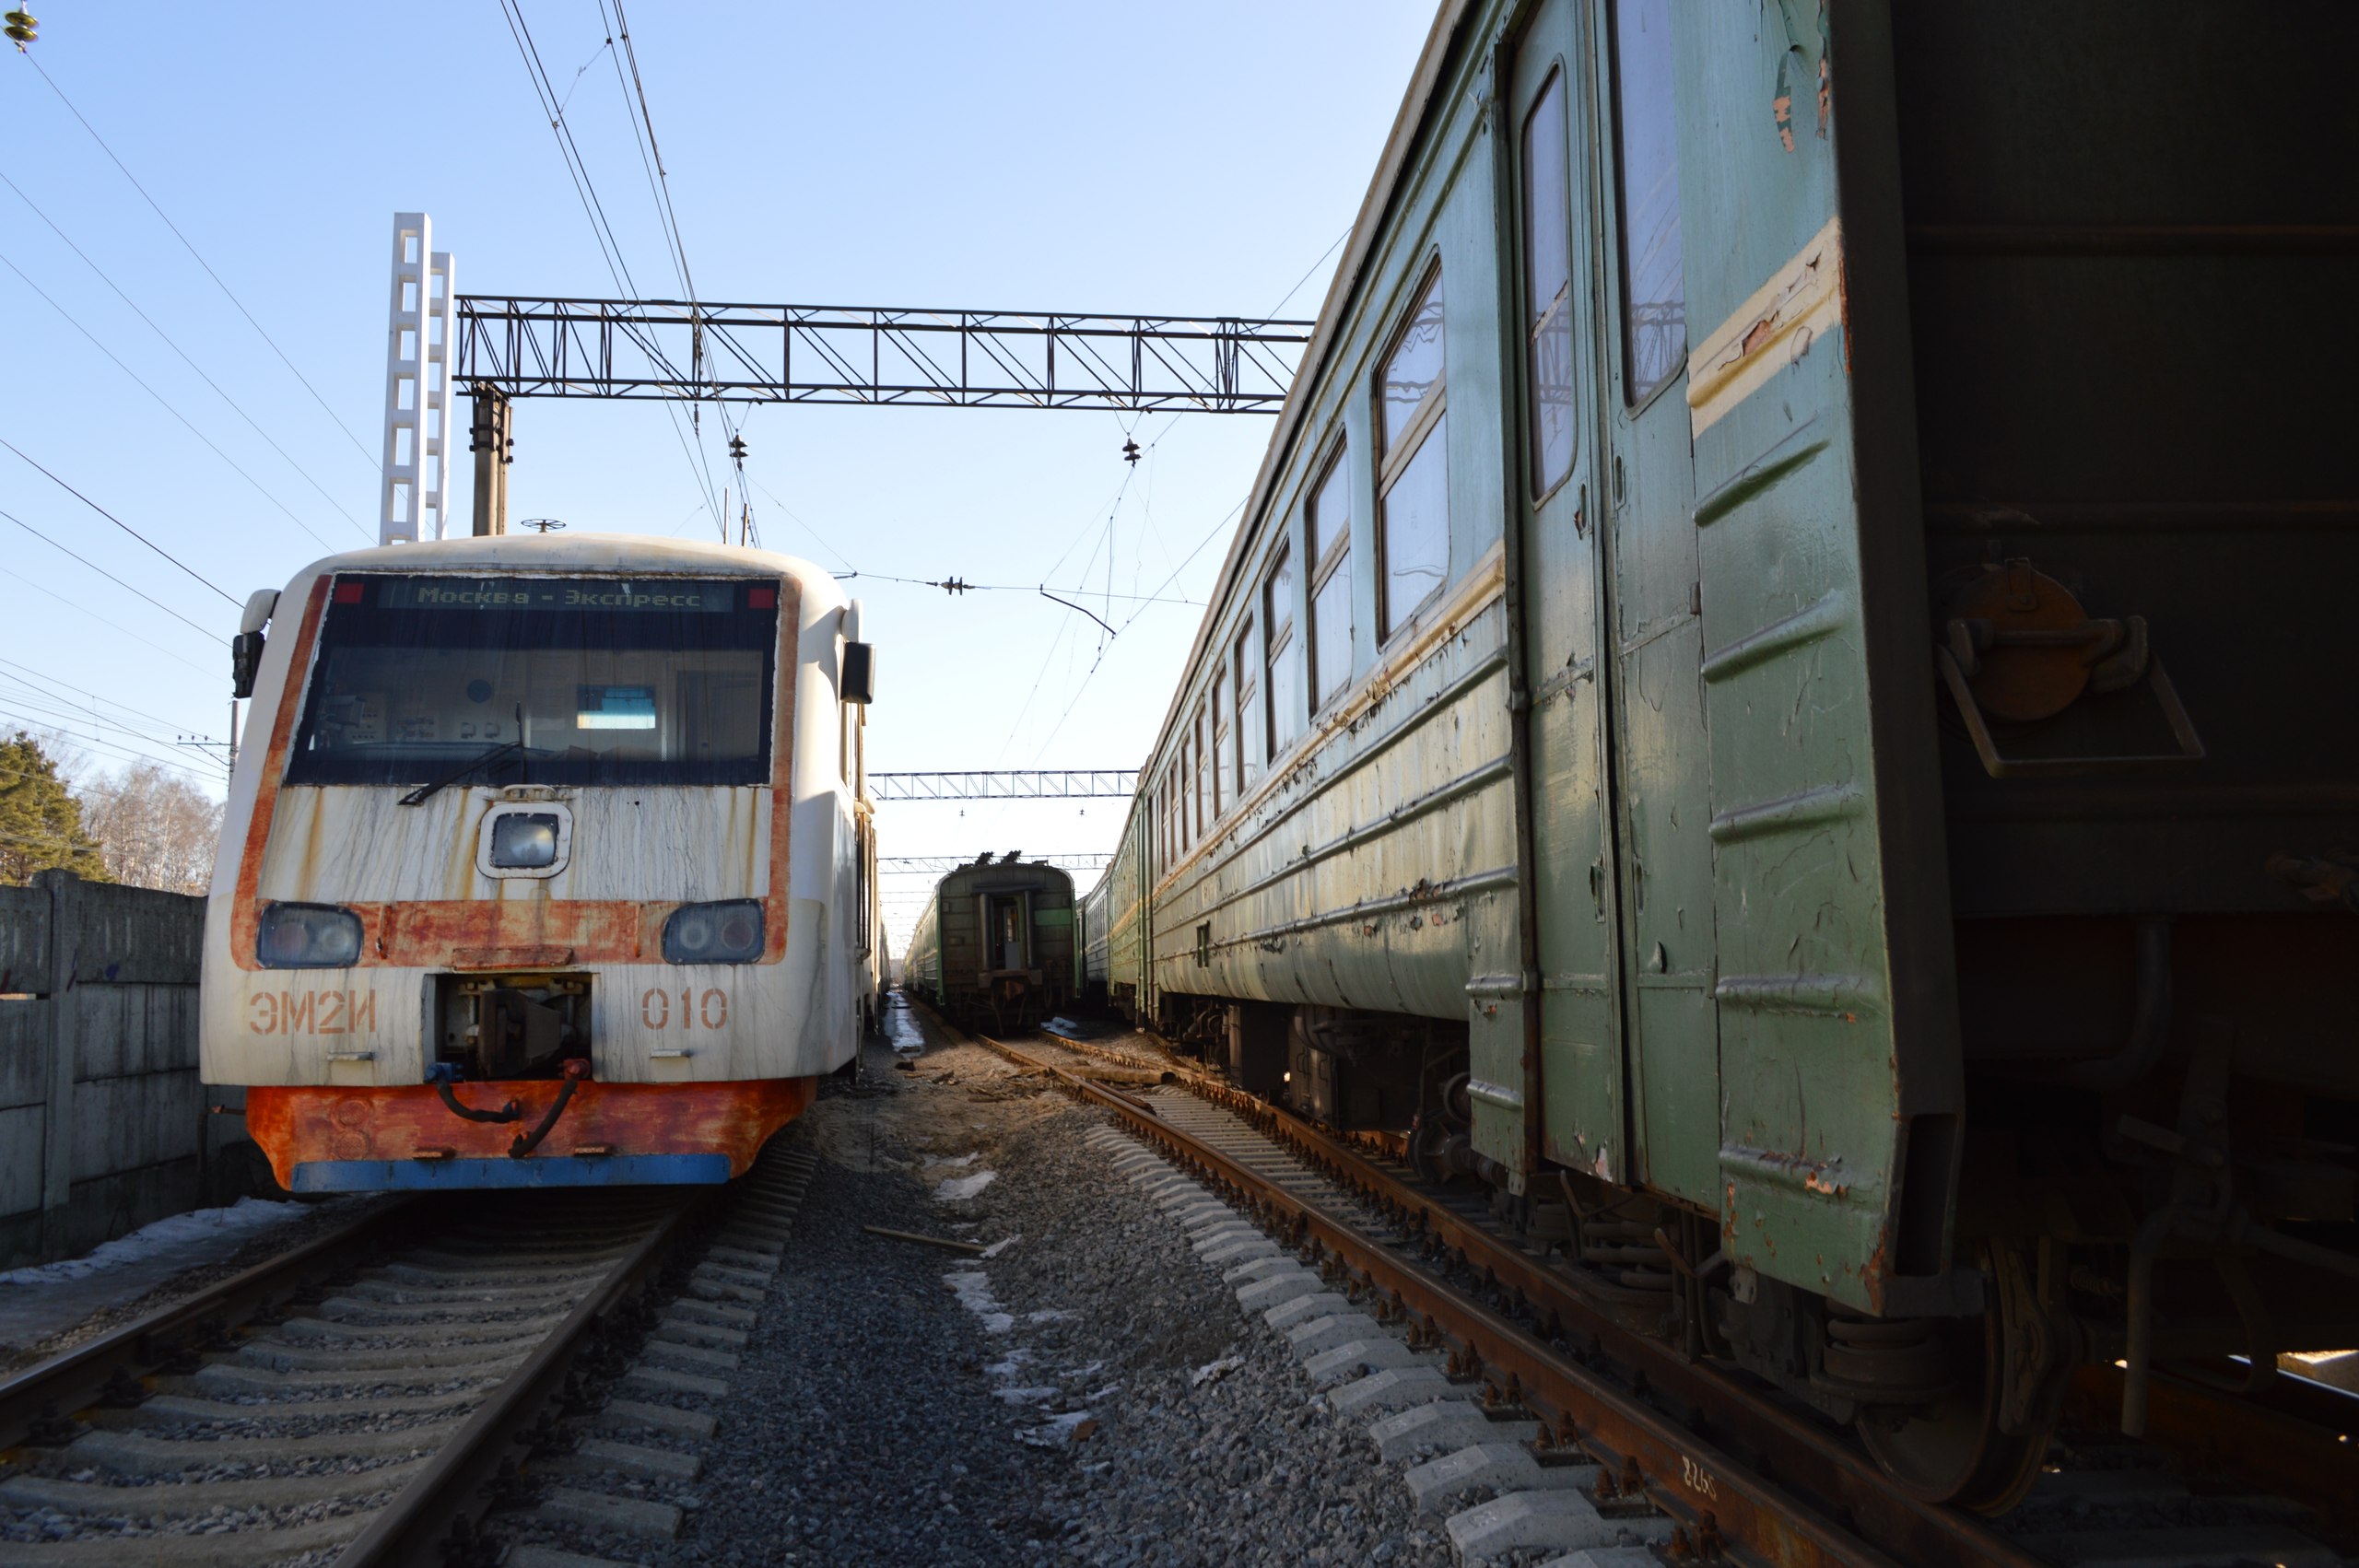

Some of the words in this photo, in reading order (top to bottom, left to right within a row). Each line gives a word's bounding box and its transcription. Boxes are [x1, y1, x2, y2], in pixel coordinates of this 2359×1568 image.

[417, 587, 529, 604] Москва
[565, 589, 700, 608] Экспресс
[250, 989, 376, 1036] ЭМ2И
[641, 987, 728, 1030] 010
